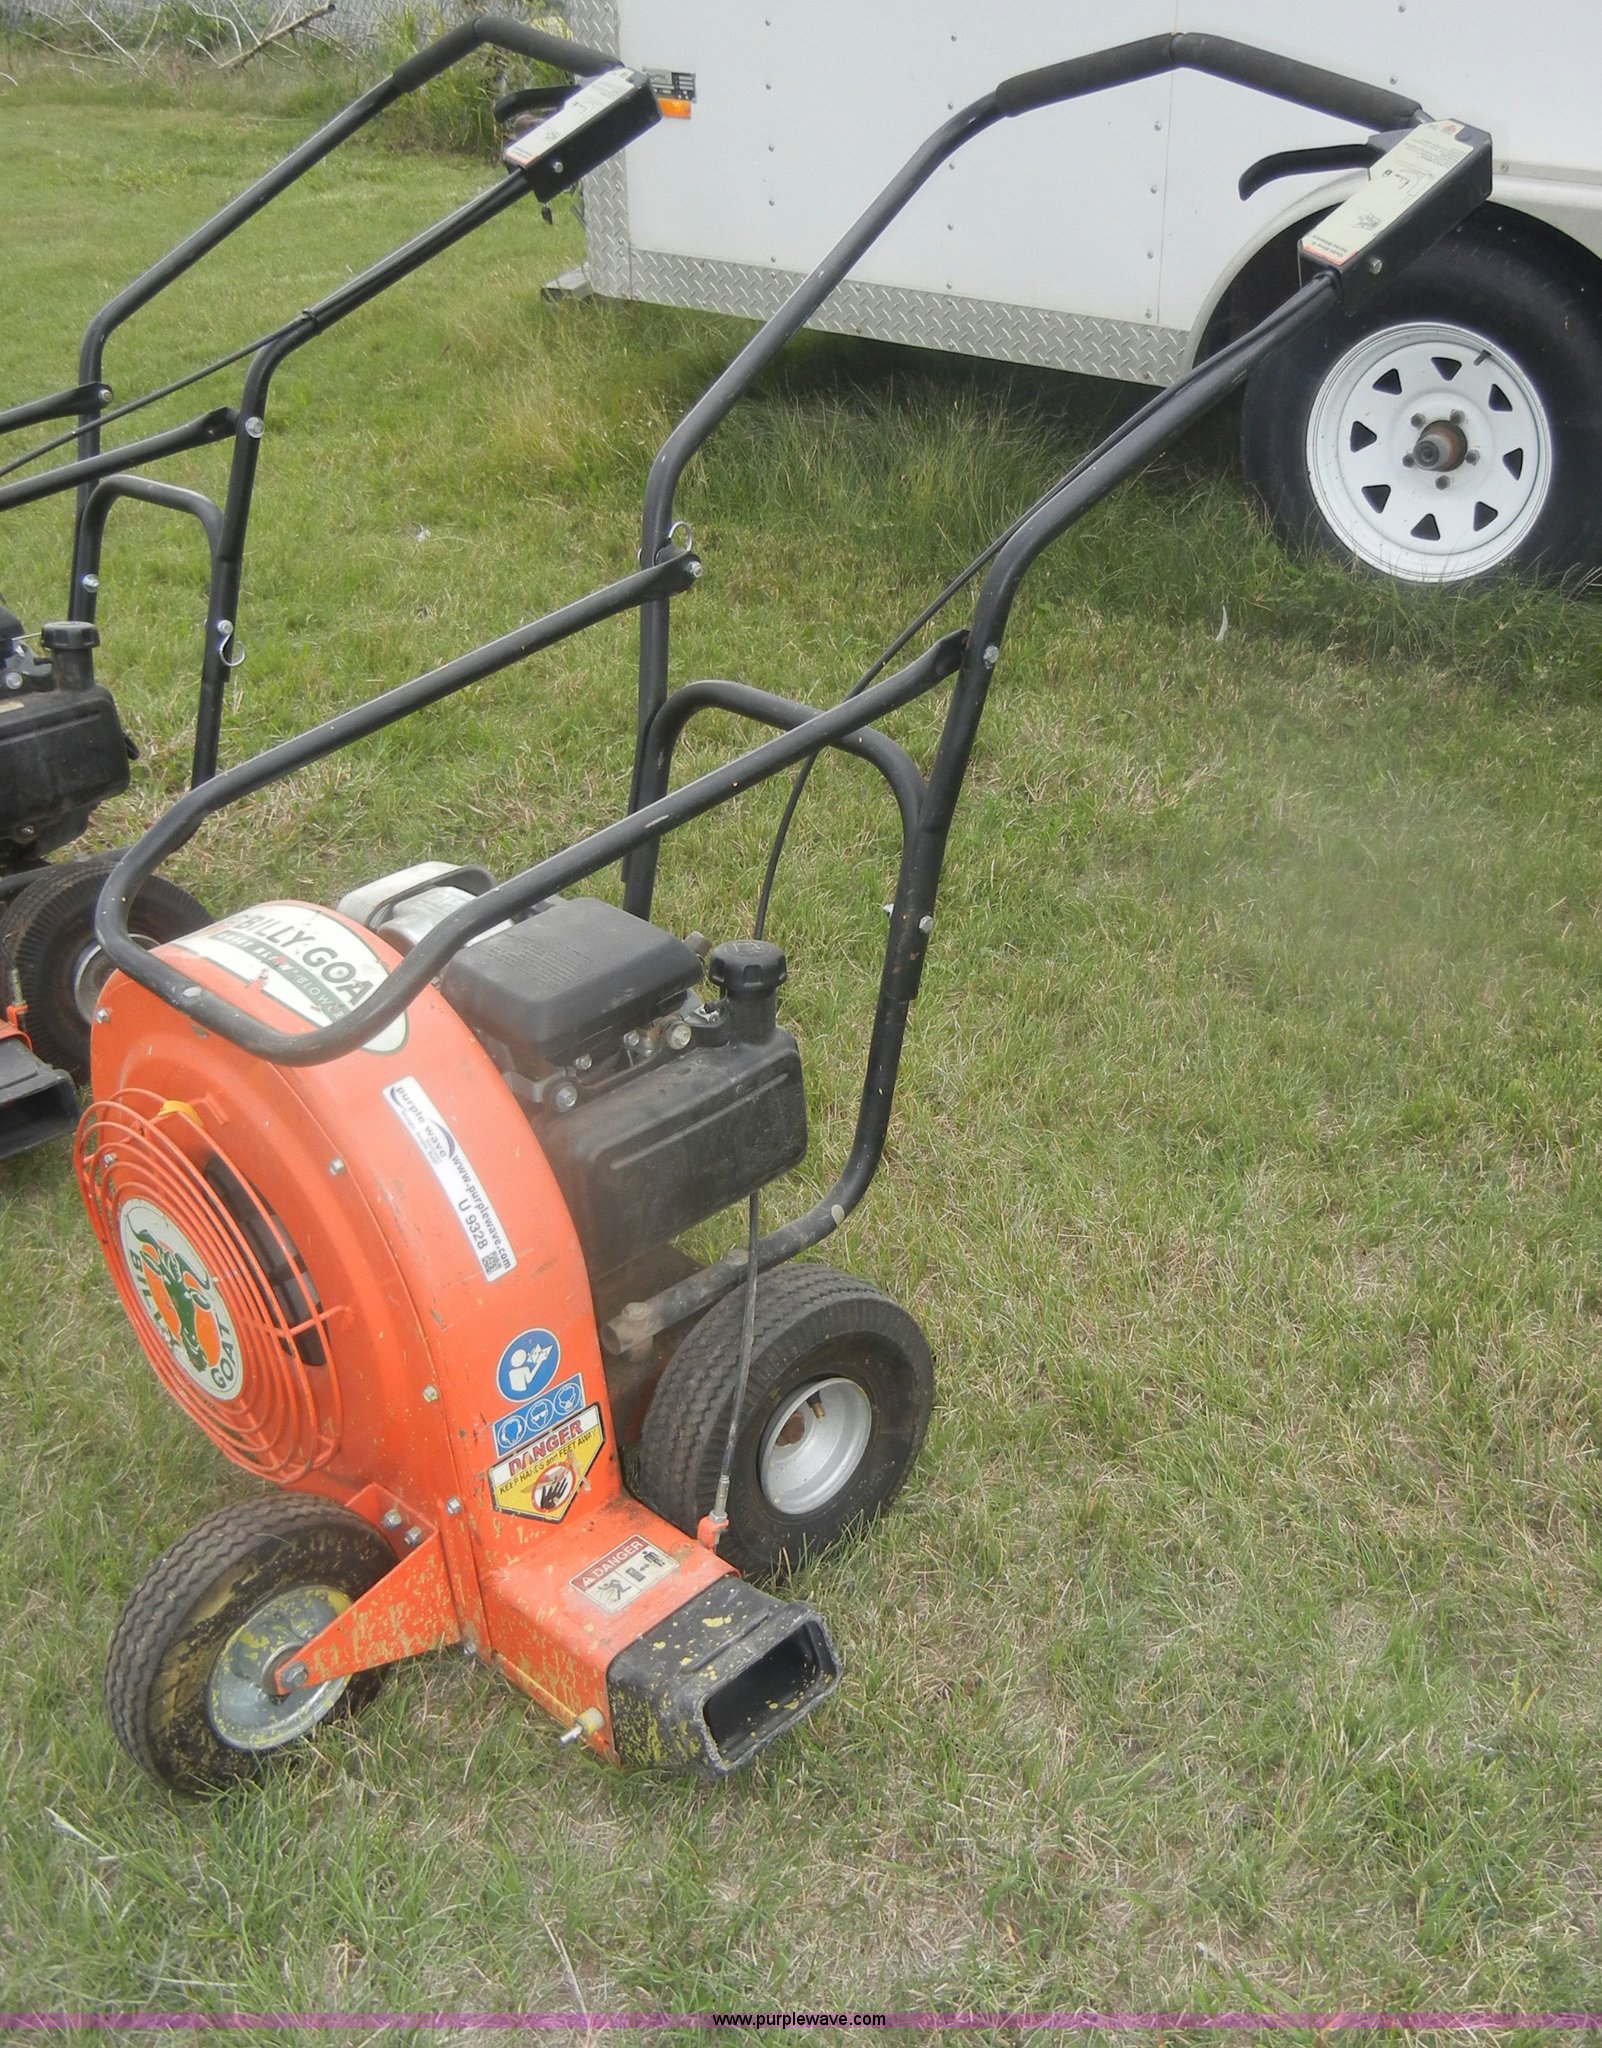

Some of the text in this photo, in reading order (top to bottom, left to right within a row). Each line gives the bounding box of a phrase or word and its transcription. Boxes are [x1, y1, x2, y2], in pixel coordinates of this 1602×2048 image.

[234, 916, 373, 1006] BILLY GOA
[396, 1086, 425, 1123] purple
[425, 1126, 447, 1158] wave
[452, 1155, 511, 1269] www.purplewave.com
[458, 1198, 488, 1250] U 9328
[130, 1249, 181, 1348] BILY
[211, 1313, 236, 1389] GOAT
[500, 1477, 519, 1494] KEEP
[559, 1442, 577, 1457] FEET
[508, 1419, 583, 1476] DANGER
[594, 1541, 644, 1577] DANGER
